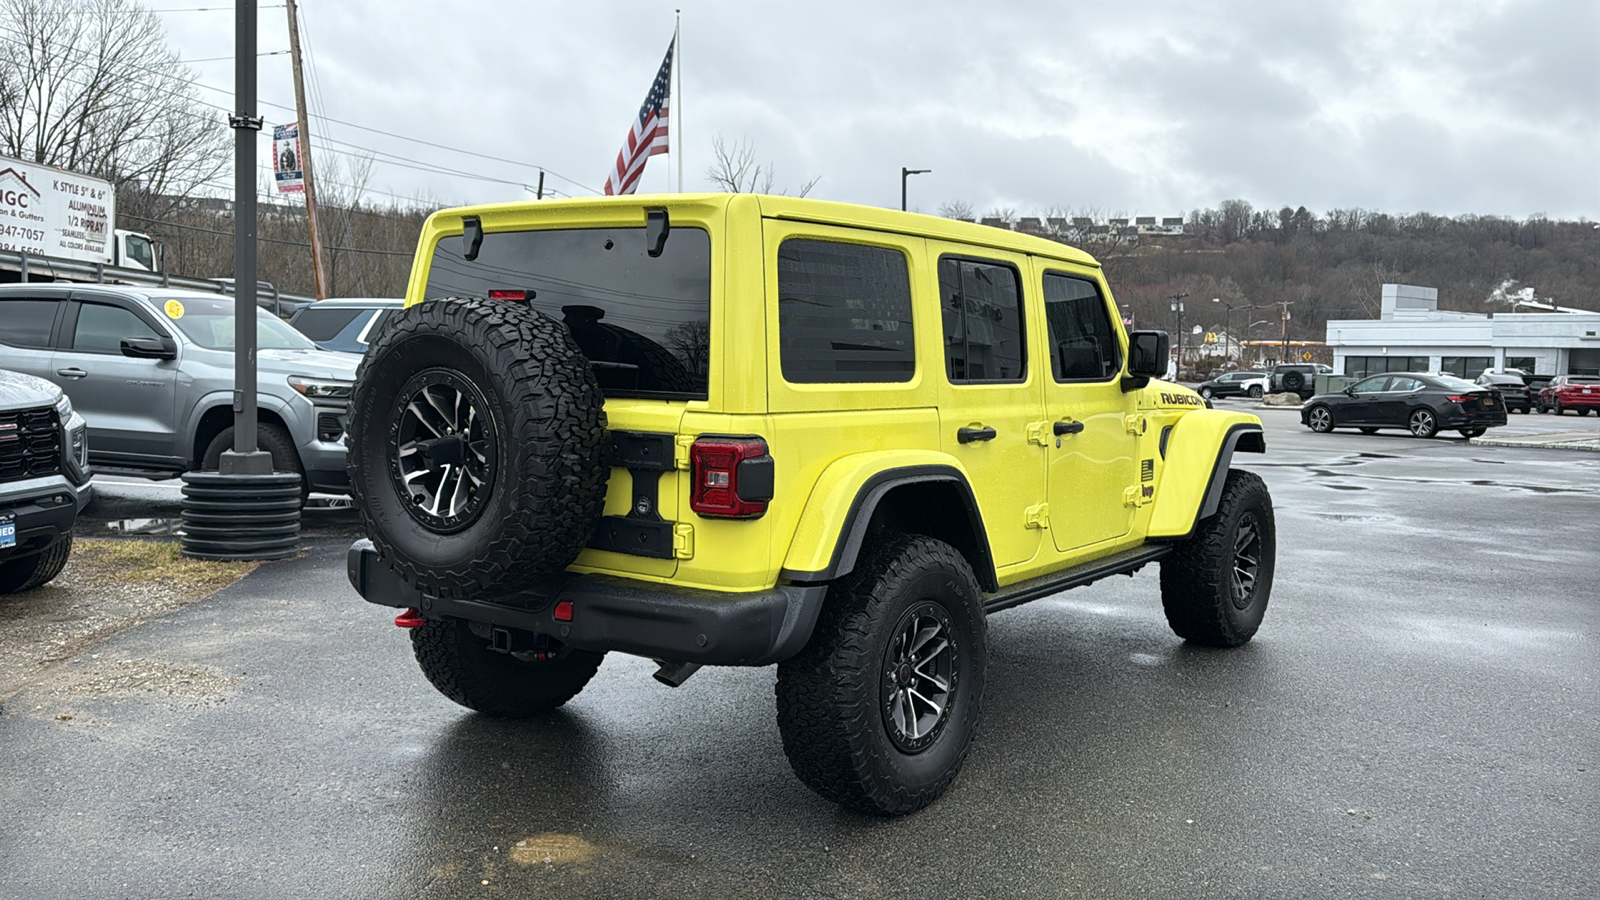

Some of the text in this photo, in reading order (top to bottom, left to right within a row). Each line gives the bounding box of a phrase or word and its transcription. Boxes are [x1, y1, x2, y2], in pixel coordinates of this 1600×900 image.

[53, 180, 59, 190] K
[60, 182, 79, 195] STYLE
[90, 188, 96, 198] &
[10, 209, 17, 217] &
[19, 210, 45, 222] Gutters
[68, 215, 79, 227] 1/2
[61, 228, 85, 240] SEAMLESS
[59, 240, 104, 253] ALL COLORS AVAILABLE
[1160, 392, 1204, 407] RUBICON
